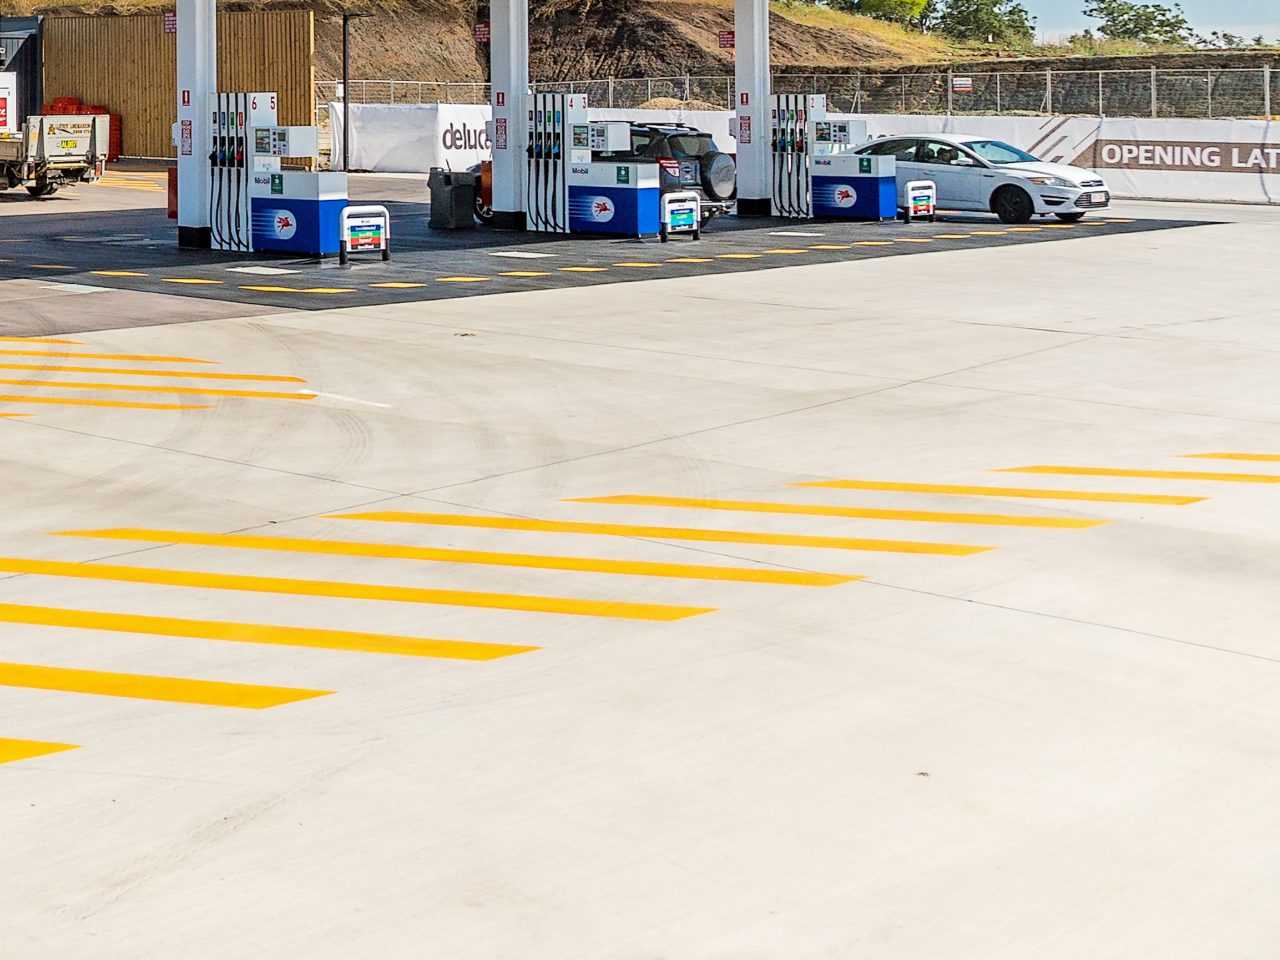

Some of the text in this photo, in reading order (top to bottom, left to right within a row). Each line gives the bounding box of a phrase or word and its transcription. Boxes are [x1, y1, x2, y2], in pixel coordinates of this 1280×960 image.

[251, 96, 276, 110] 6 5
[442, 122, 492, 150] deluc
[1101, 143, 1280, 169] OPENING LAT
